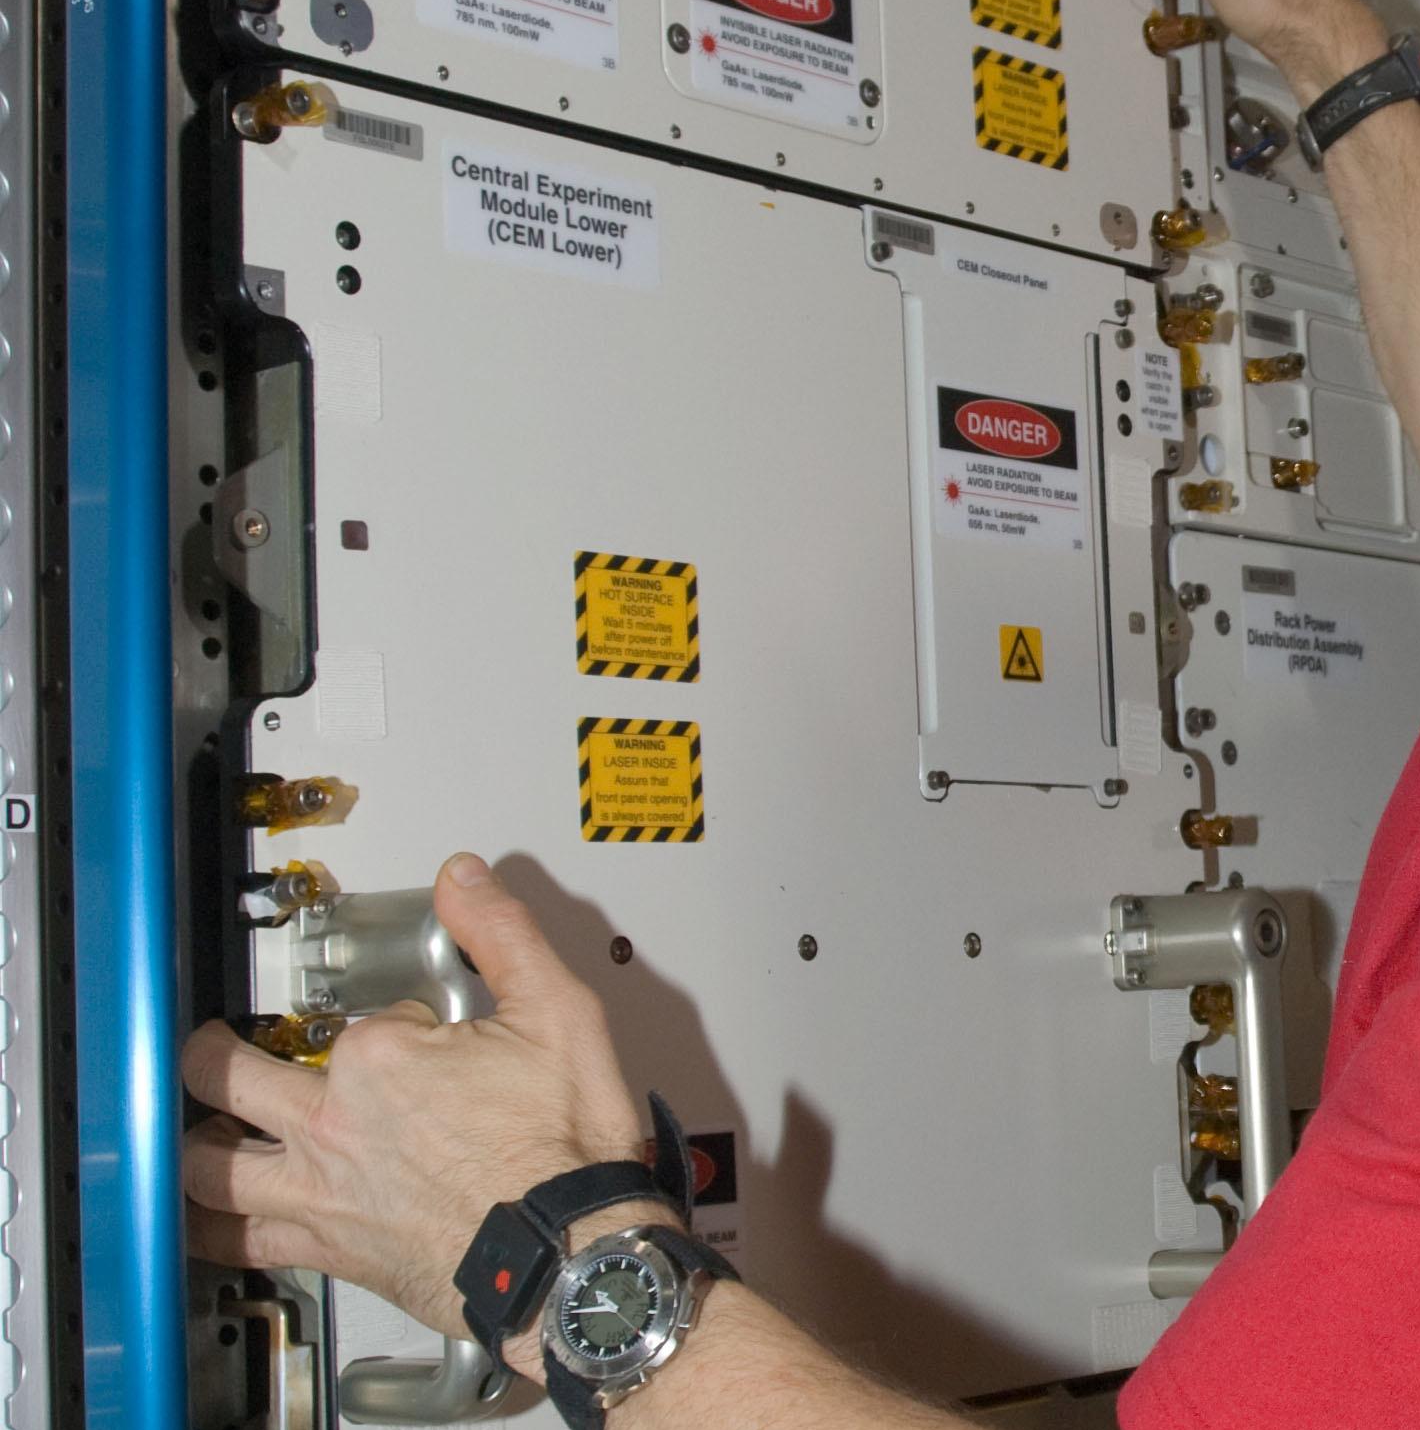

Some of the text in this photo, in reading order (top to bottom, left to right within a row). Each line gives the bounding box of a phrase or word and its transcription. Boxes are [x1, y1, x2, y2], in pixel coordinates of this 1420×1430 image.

[455, 10, 540, 42] 785 nm, 100mW
[491, 3, 555, 32] Laserdiode,
[719, 15, 854, 64] INVISIBLE LASER RADIATION
[601, 57, 615, 70] 3B
[721, 30, 849, 76] AVOID EXPOSURE TO BEAM
[721, 58, 751, 76] GaAs:
[722, 74, 739, 89] 785
[760, 84, 794, 104] 100mW
[452, 155, 653, 220] Central Experiment
[480, 189, 628, 239] Module Lower
[488, 218, 622, 270] (CEM Lower)
[956, 258, 1048, 290] CEM Closeout Panel
[1145, 352, 1168, 367] NOTE
[967, 412, 1048, 446] DANGER
[966, 463, 1042, 483] LASER RADIATION
[967, 477, 1078, 502] AVOID EXPOSURE TO BEAM
[611, 576, 662, 591] WARNING
[599, 589, 674, 606] HOT SURFACE
[620, 604, 656, 618] INSIDE
[1274, 610, 1336, 633] Rack Power
[1247, 627, 1364, 661] Distribution Assembly
[614, 738, 666, 751] WARNING
[603, 756, 678, 770] LASER INSIDE
[614, 775, 669, 786] Assure that
[649, 795, 688, 807] opening
[6, 798, 31, 830] D
[647, 811, 685, 822] covered
[707, 1231, 736, 1245] BEAM
